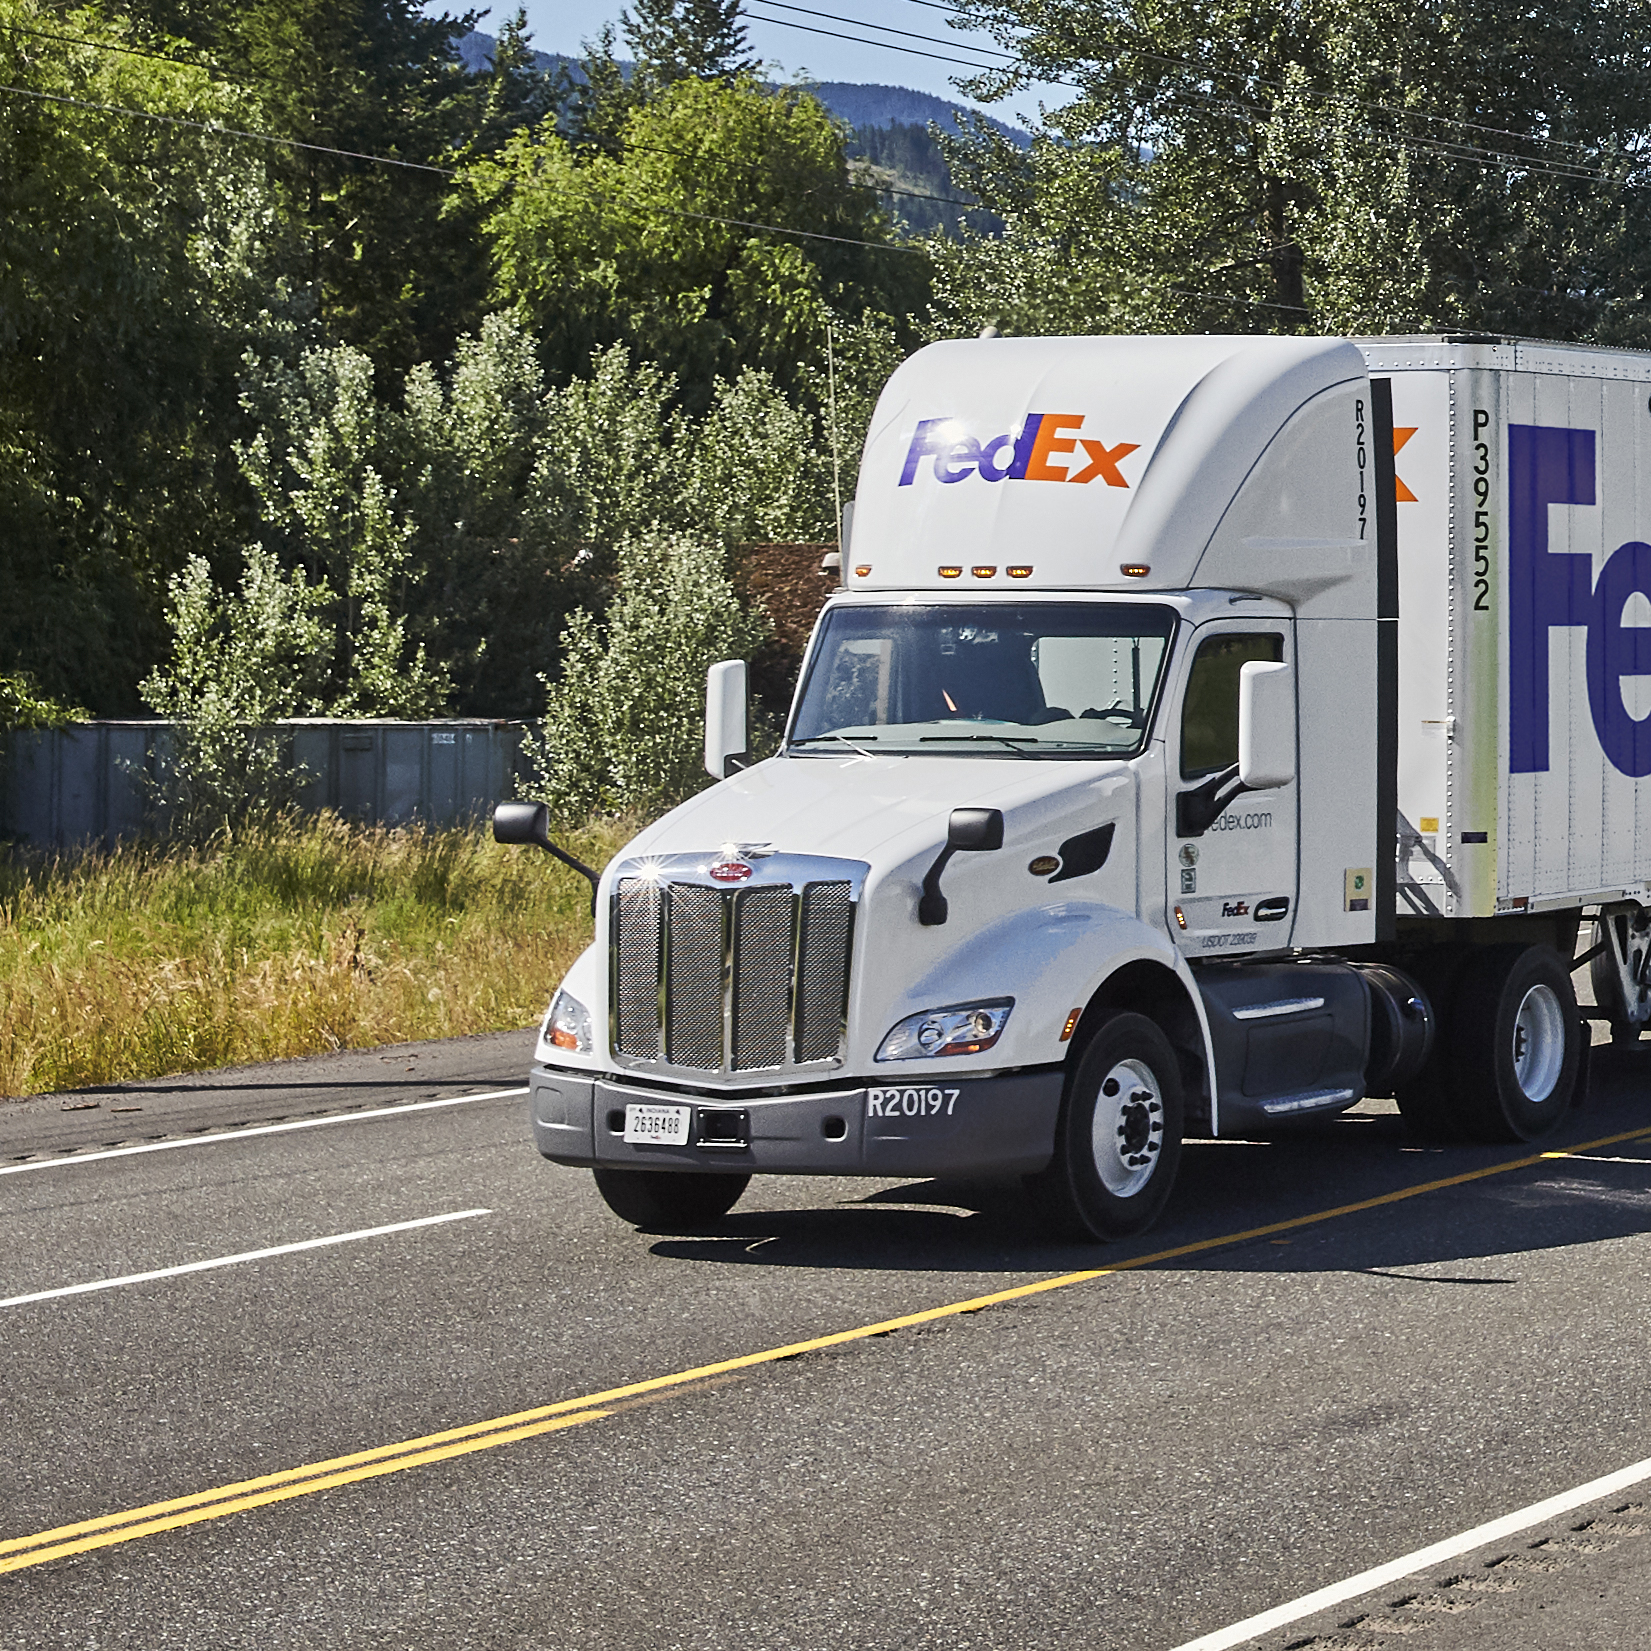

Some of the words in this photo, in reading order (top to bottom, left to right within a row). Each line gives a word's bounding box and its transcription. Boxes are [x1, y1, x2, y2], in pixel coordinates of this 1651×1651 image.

[898, 413, 1141, 488] FedEx
[1355, 399, 1367, 540] R20197
[1473, 409, 1489, 611] P39552
[1222, 901, 1250, 918] FedEx
[633, 1116, 680, 1134] 2636488
[867, 1088, 961, 1116] R20197
